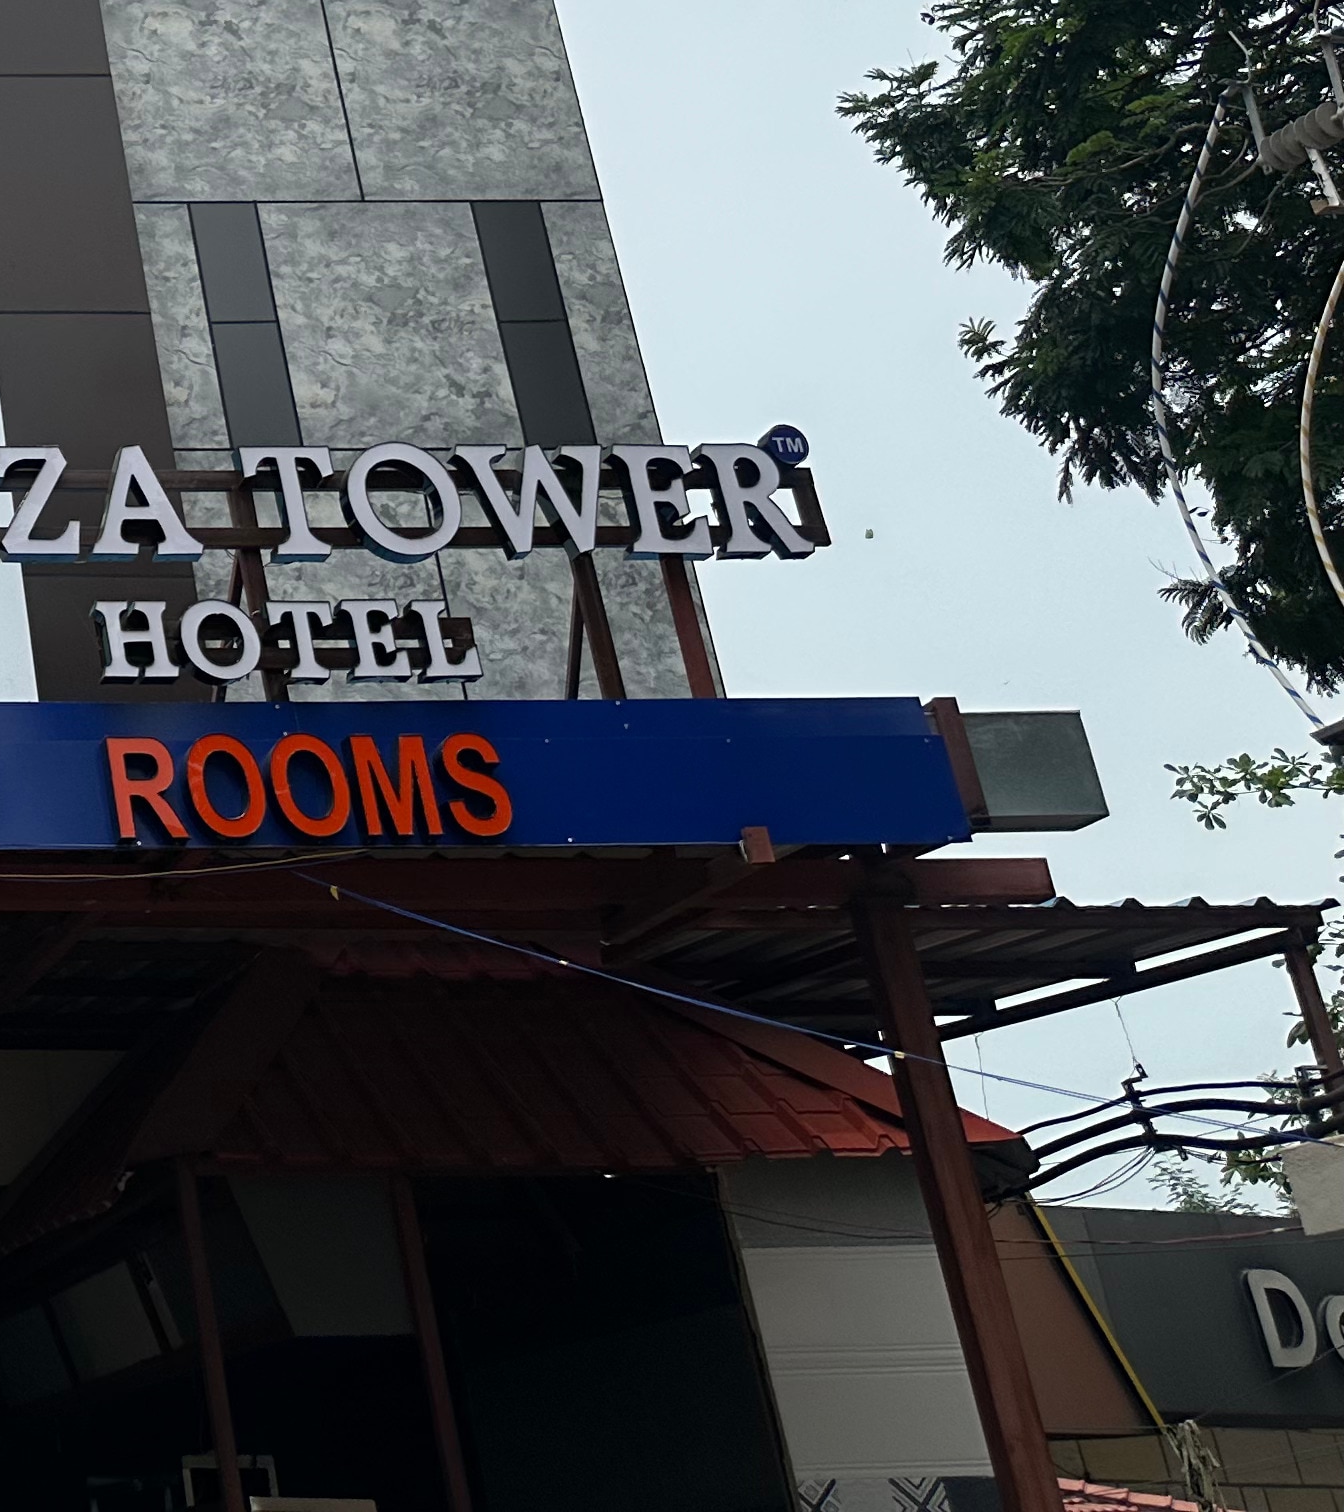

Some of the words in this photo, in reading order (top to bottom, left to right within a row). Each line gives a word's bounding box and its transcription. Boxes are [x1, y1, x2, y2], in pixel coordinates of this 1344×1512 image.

[236, 440, 815, 562] TOWER
[90, 598, 485, 685] HOTEL
[104, 732, 513, 839] ROOMS
